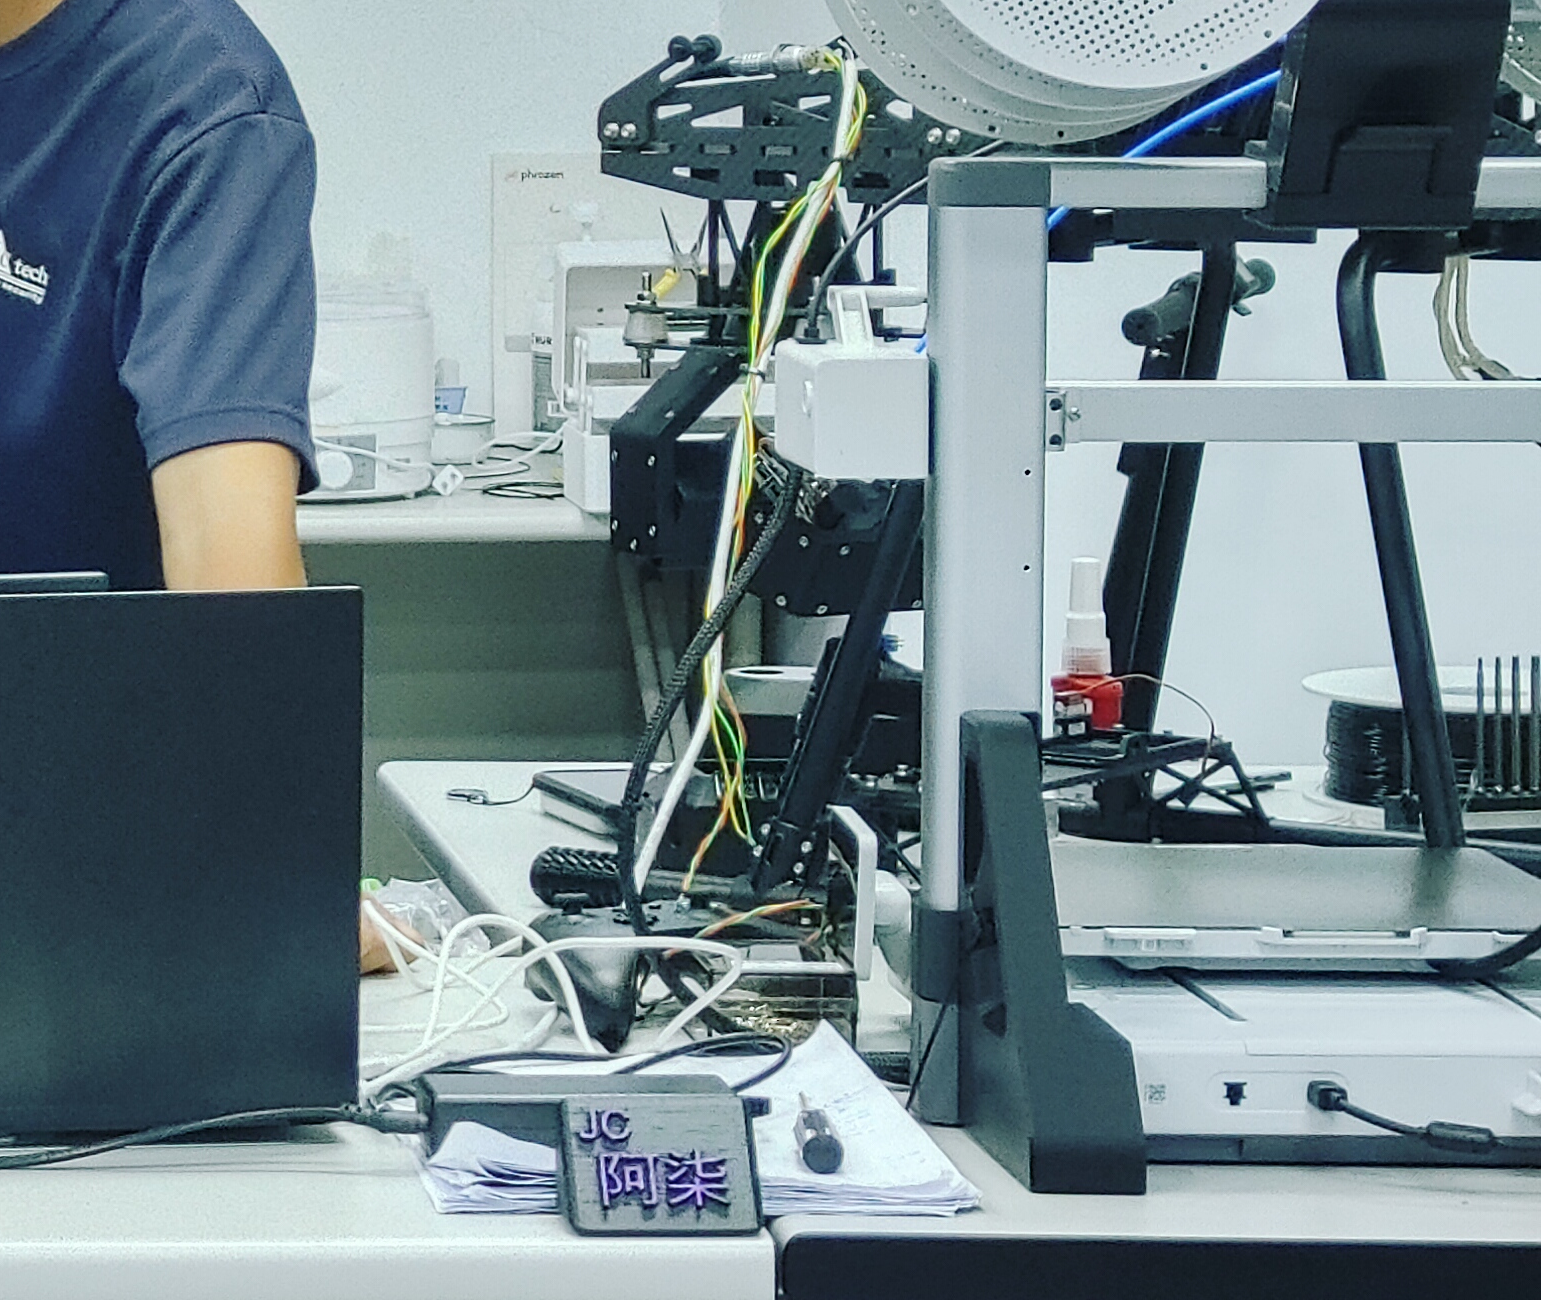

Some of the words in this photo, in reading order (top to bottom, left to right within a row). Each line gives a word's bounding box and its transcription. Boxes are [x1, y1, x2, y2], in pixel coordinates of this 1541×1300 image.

[520, 169, 564, 182] phrozen
[579, 1108, 632, 1141] JC
[598, 1150, 731, 1208] 阿柒
